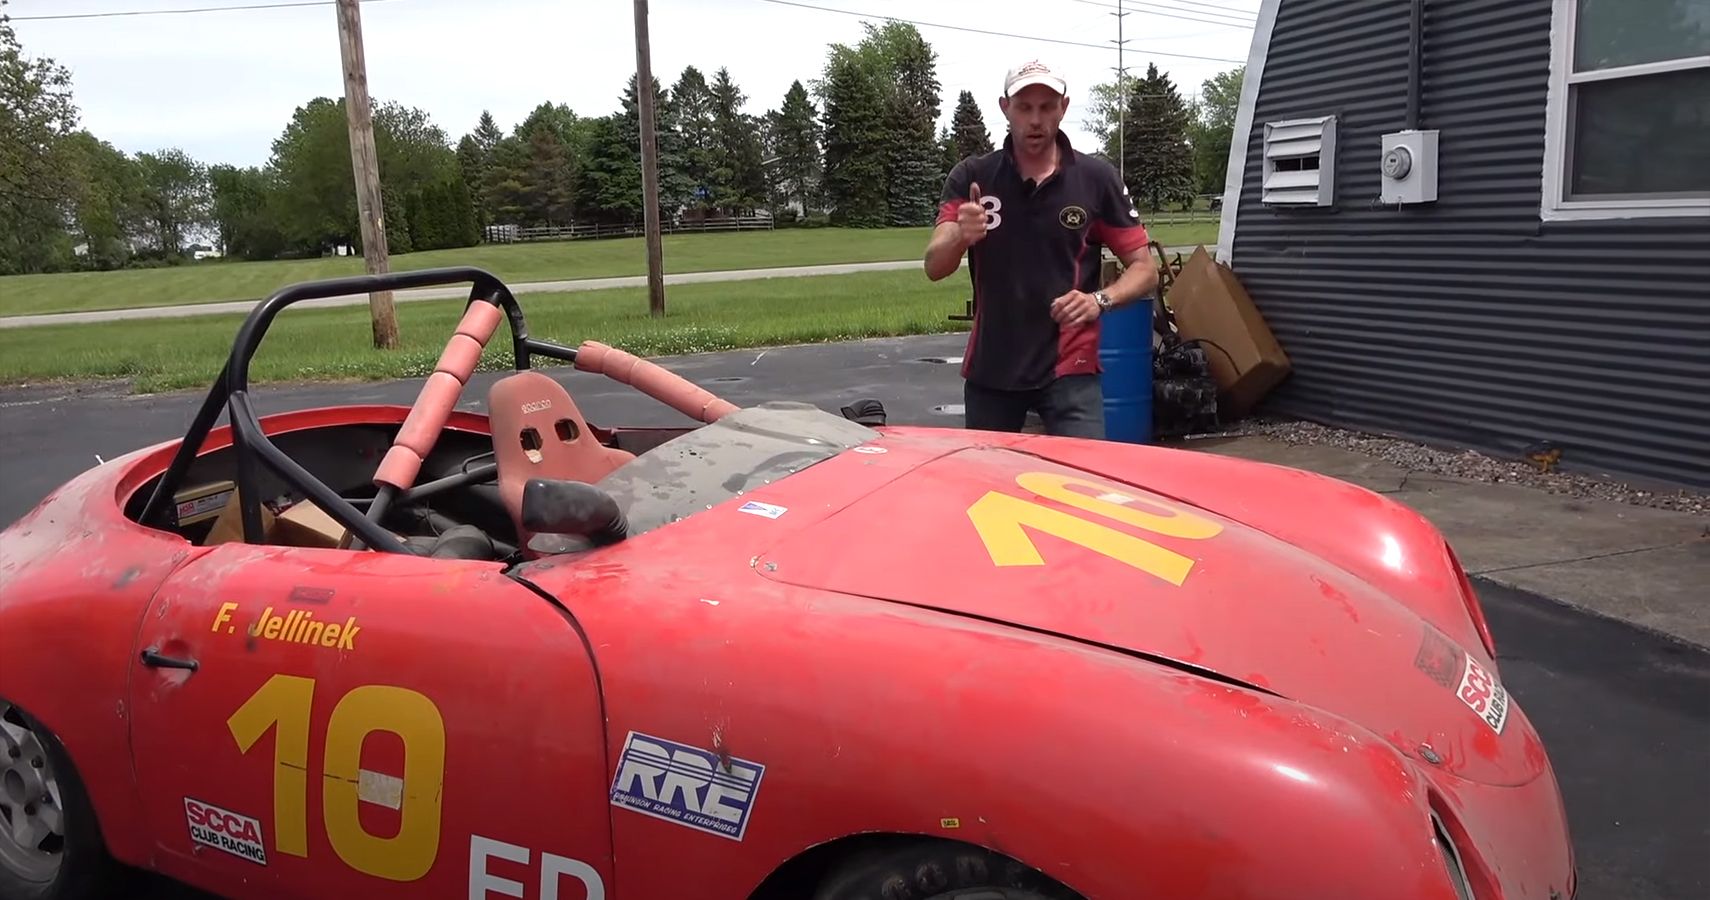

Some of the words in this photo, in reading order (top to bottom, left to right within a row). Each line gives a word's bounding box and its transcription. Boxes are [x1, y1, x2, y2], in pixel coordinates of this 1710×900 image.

[980, 196, 1001, 230] 3
[966, 471, 1225, 587] 10
[211, 602, 239, 634] F.
[248, 606, 361, 651] Jellinek
[226, 673, 447, 882] 10
[617, 738, 757, 824] RRE
[187, 802, 261, 845] SCCA
[653, 804, 682, 817] RACING
[683, 813, 738, 834] ENTERPRISES
[191, 825, 220, 845] CLUB
[220, 835, 265, 861] RACING
